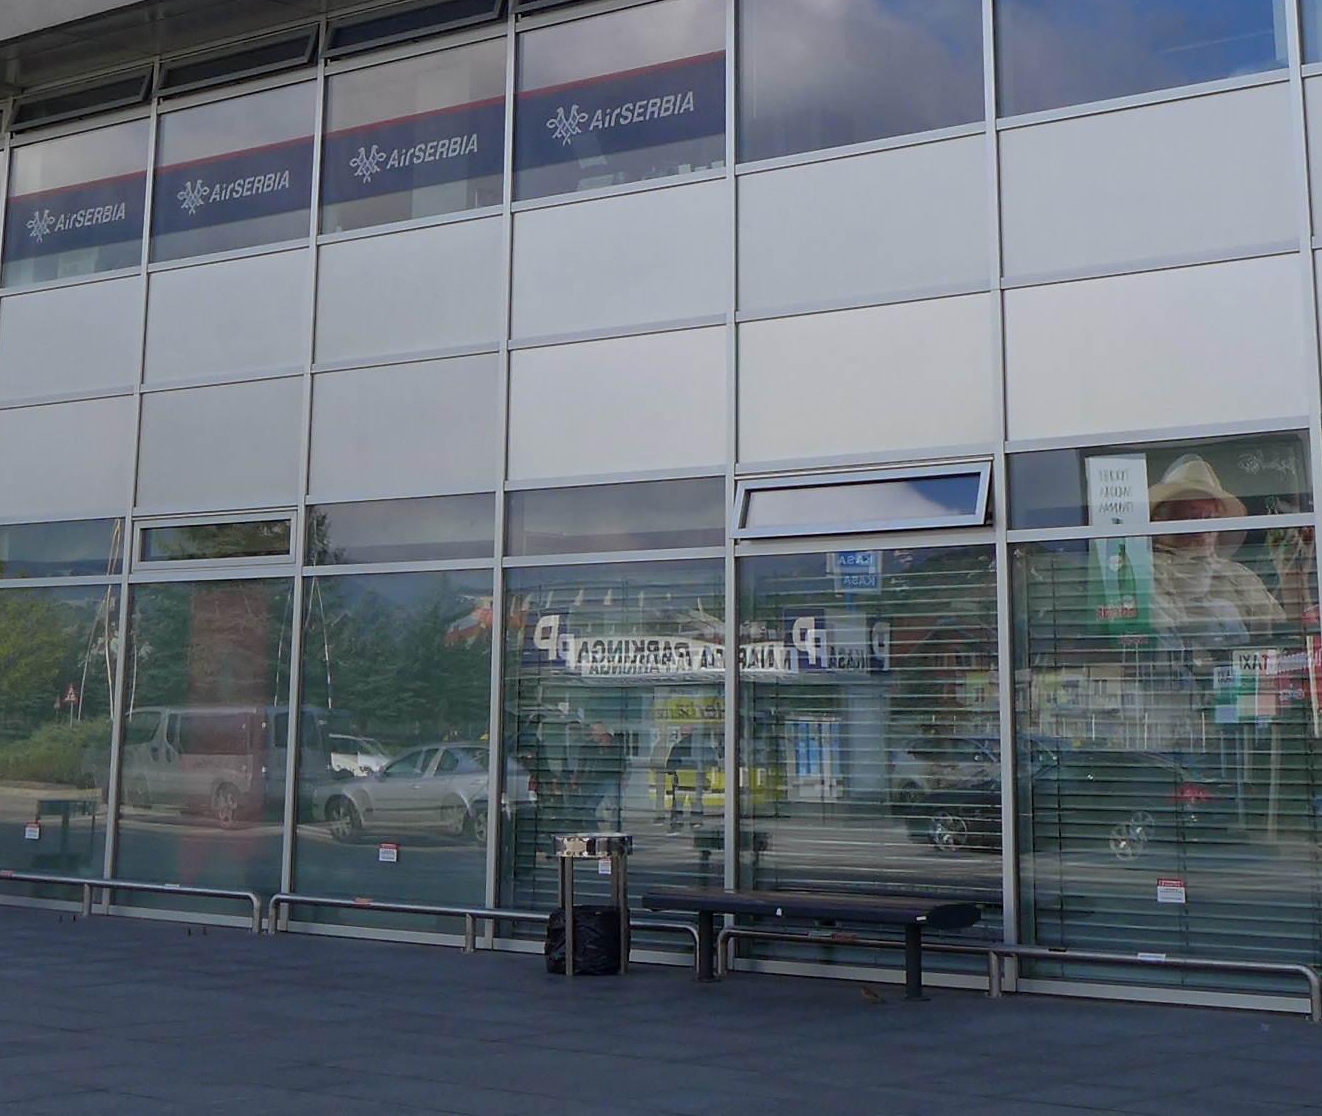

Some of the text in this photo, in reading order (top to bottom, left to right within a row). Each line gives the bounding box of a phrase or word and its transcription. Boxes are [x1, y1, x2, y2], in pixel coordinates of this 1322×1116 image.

[587, 91, 695, 131] AirSERBIA
[386, 133, 478, 170] AirSERBIA
[208, 170, 291, 204] AirSERBIA
[54, 202, 126, 232] AirSERBIA
